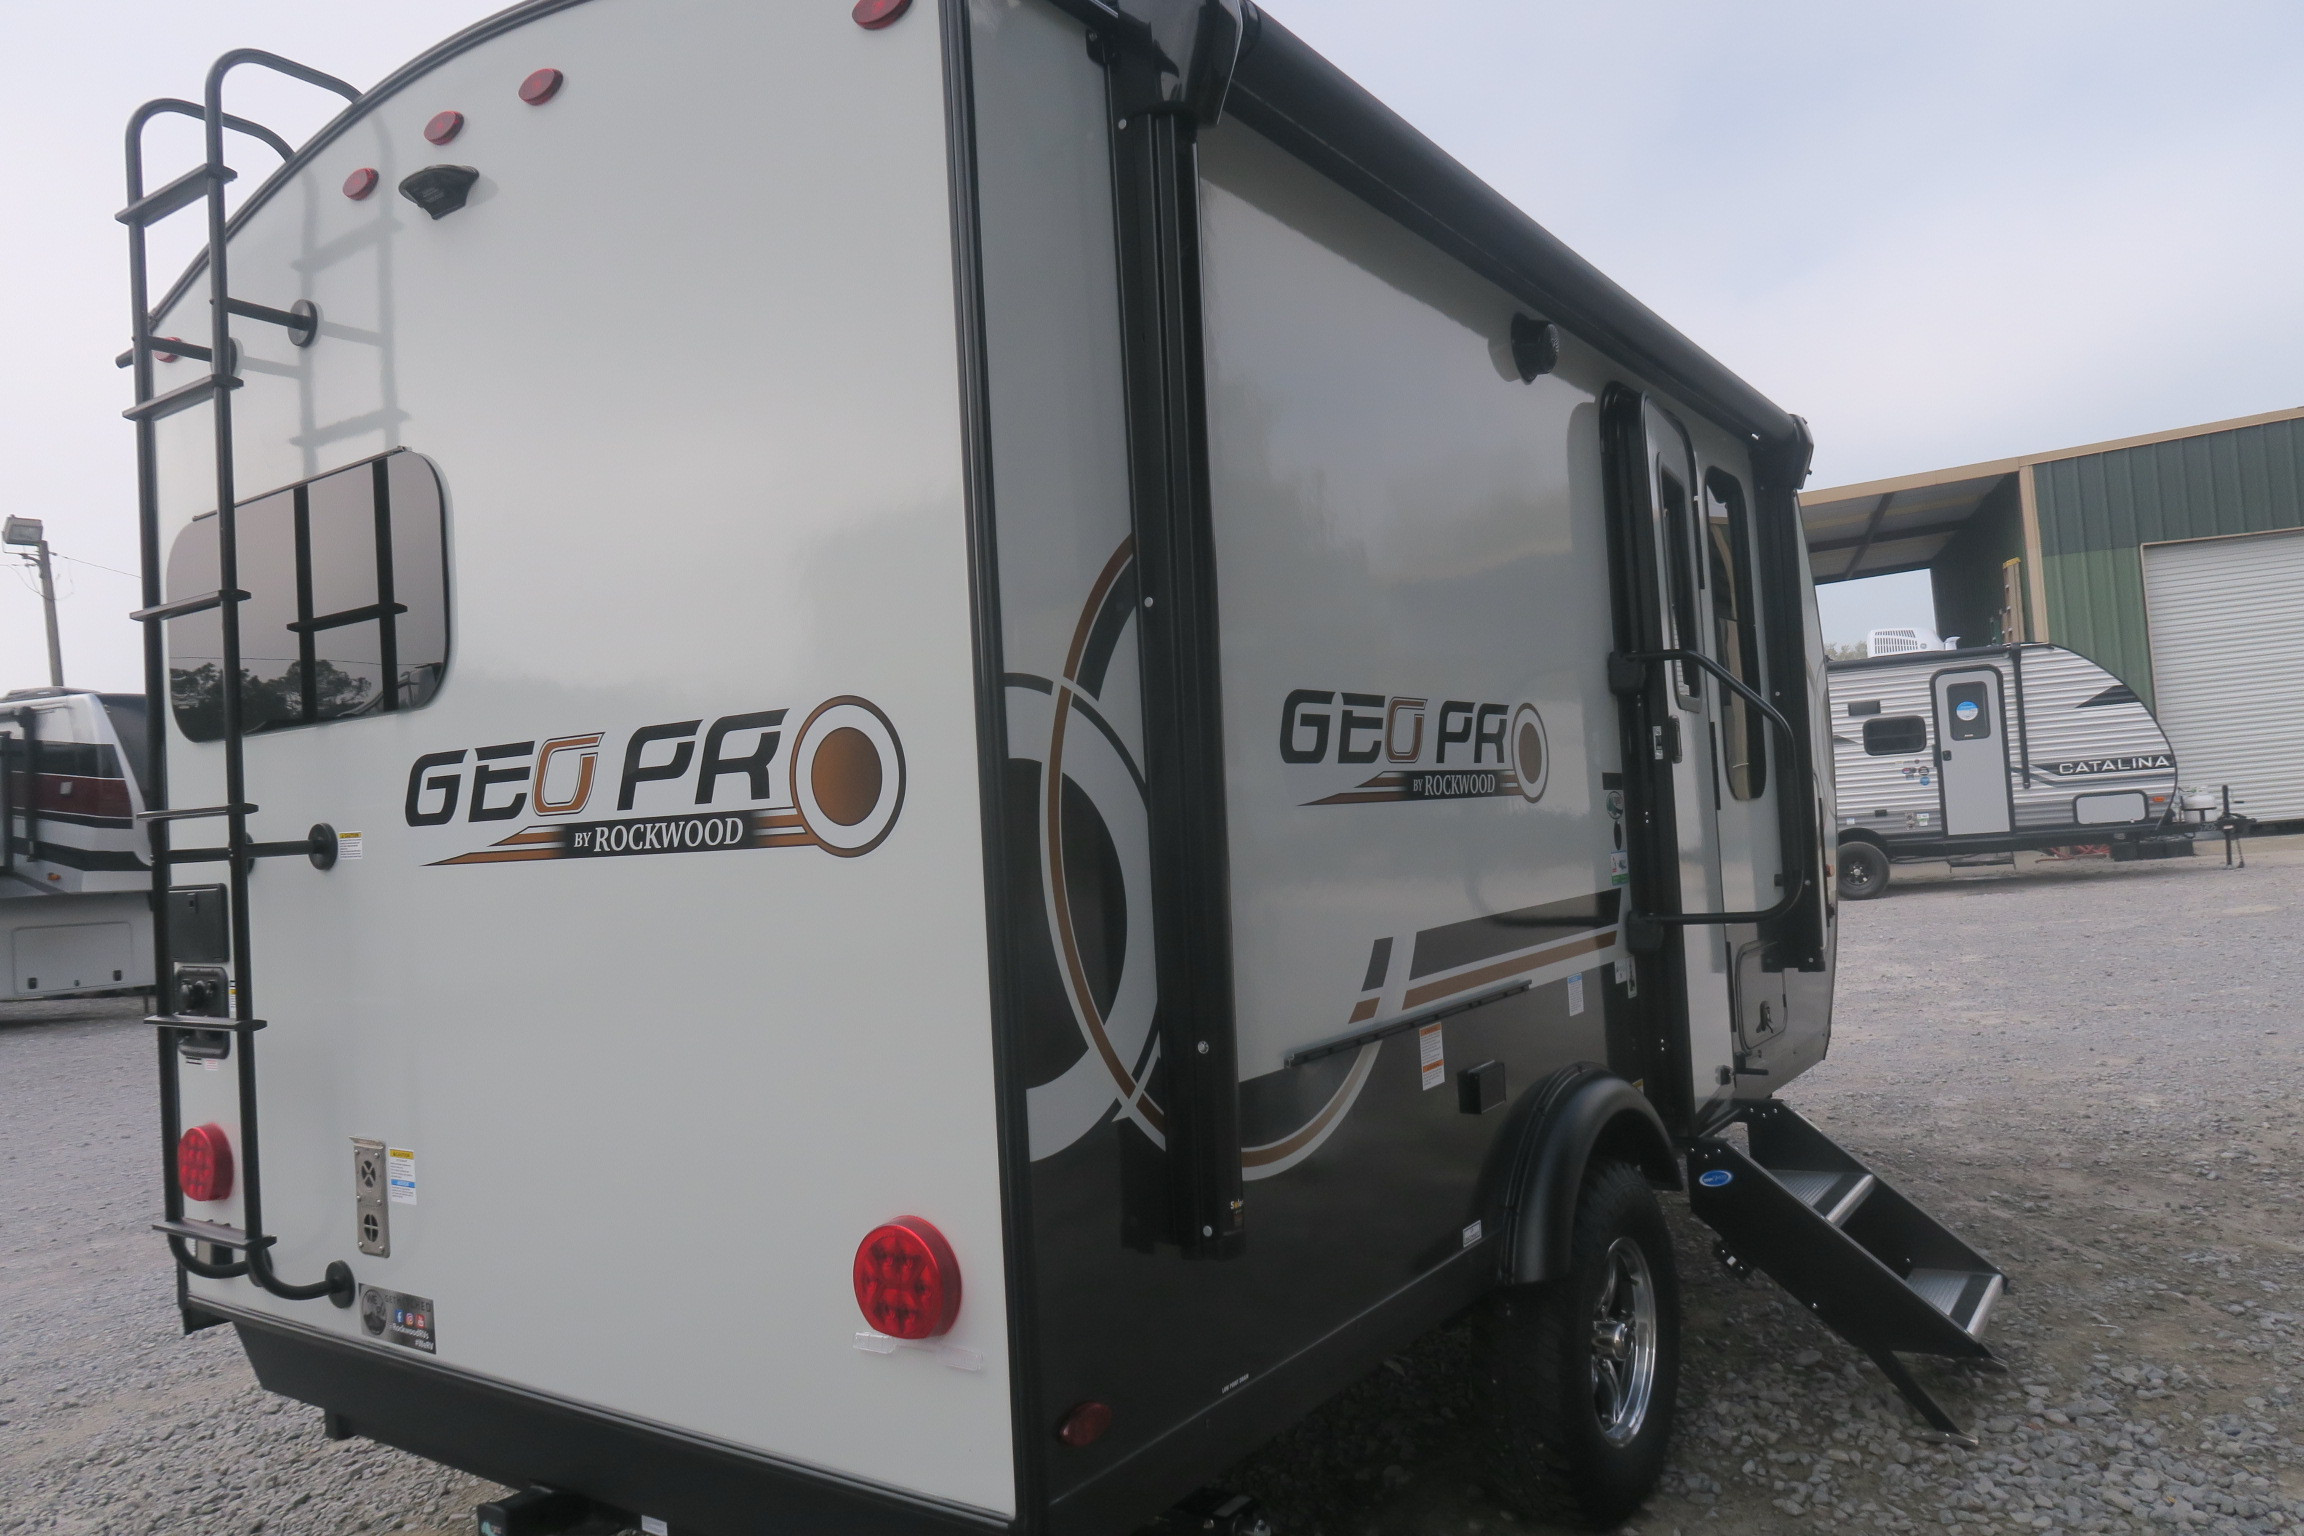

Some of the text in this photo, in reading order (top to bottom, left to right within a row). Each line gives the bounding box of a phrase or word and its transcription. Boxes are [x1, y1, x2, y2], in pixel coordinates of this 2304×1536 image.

[1279, 688, 1428, 764] GEO
[406, 732, 605, 827] GEO
[2059, 755, 2170, 774] CATALINA
[1413, 774, 1496, 796] BY ROCKWOOD
[574, 817, 744, 853] BY ROCKWOOD
